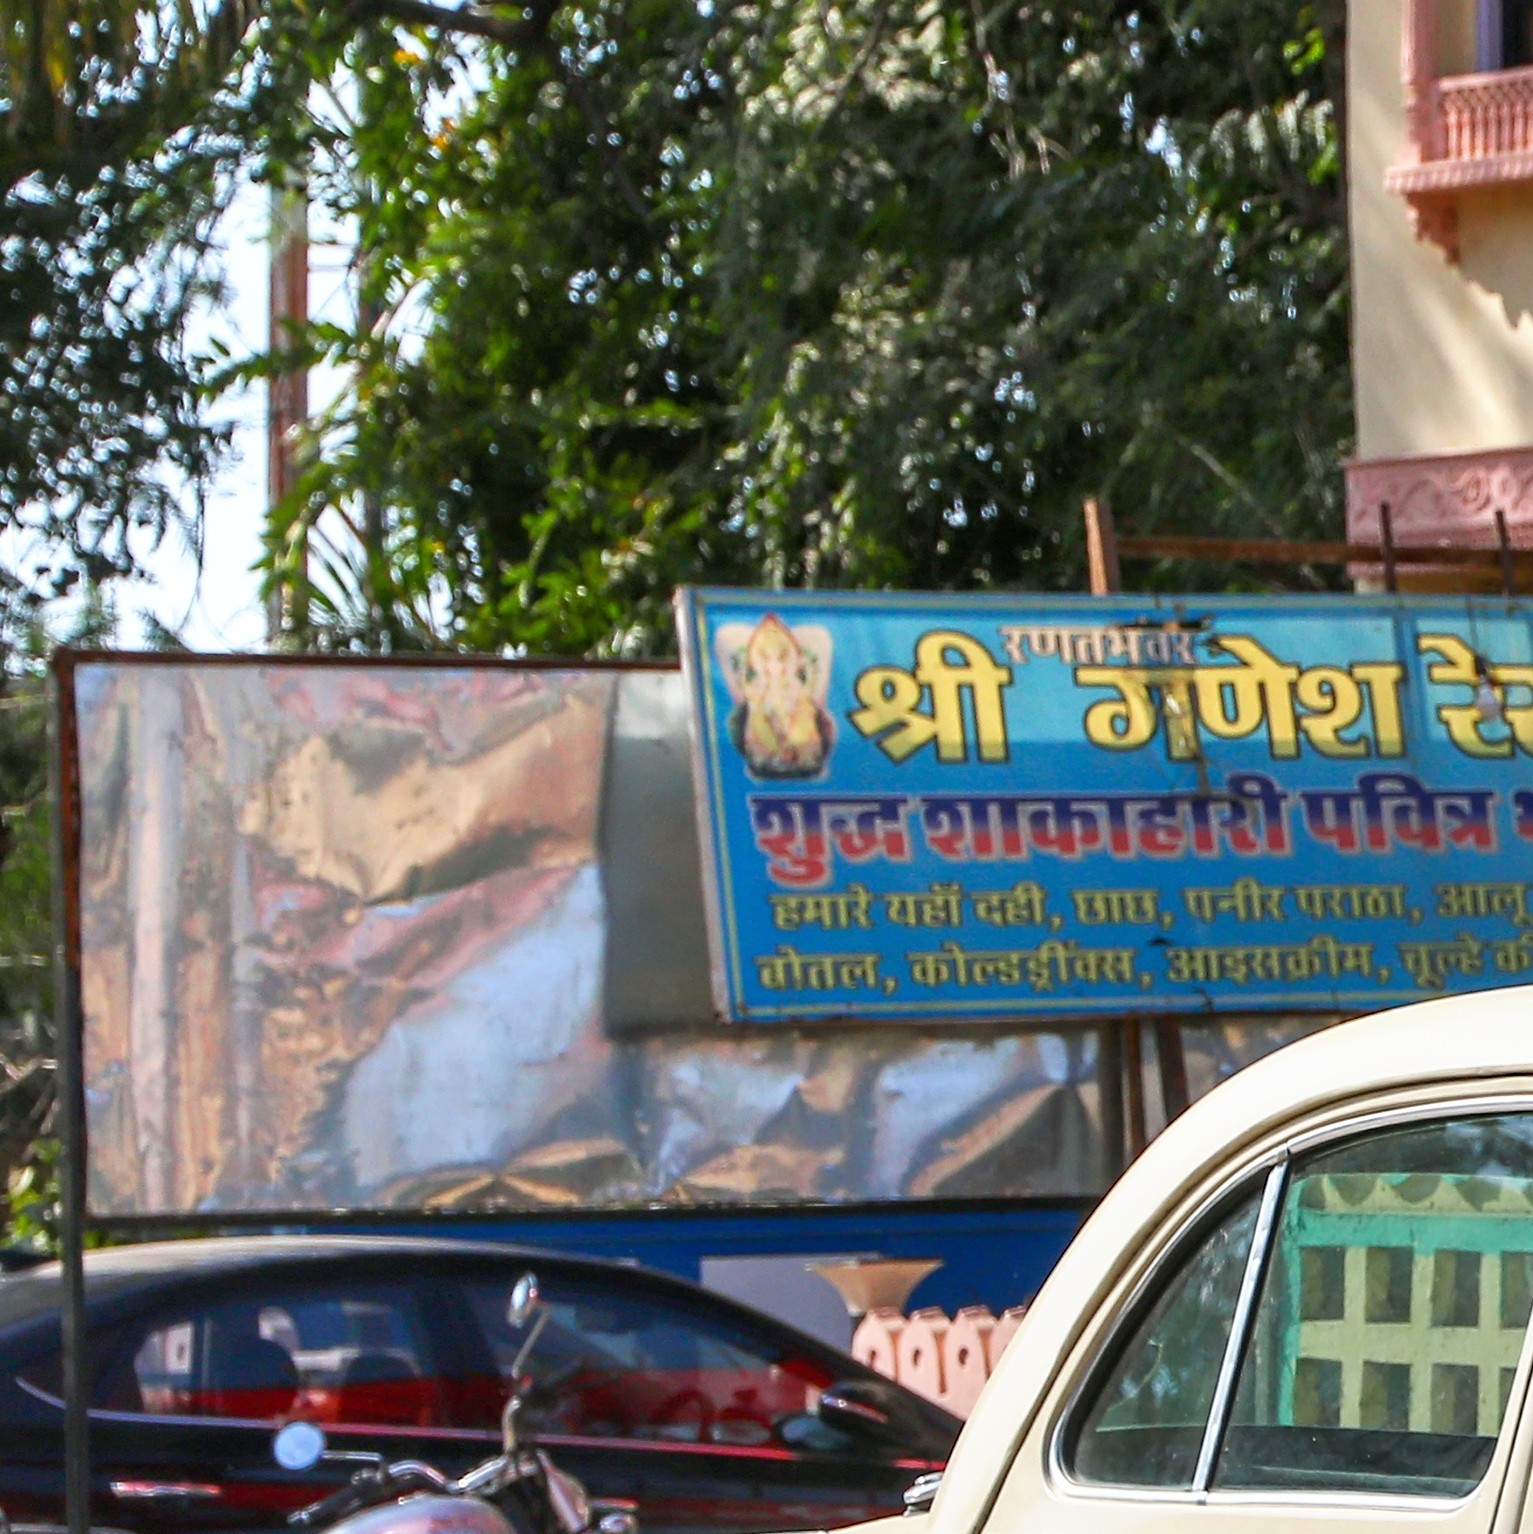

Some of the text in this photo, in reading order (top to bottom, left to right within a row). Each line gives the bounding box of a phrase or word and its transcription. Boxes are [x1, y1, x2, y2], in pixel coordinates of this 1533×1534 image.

[846, 629, 1013, 765] श्री
[1074, 633, 1406, 761] गणेश
[749, 794, 908, 887] शुद्ध
[919, 772, 1293, 862] शाकाहारी
[1299, 771, 1496, 855] पवित्र
[769, 882, 875, 930] हमारे
[1181, 877, 1287, 922] पनीर
[1397, 931, 1483, 990] चूल्हे
